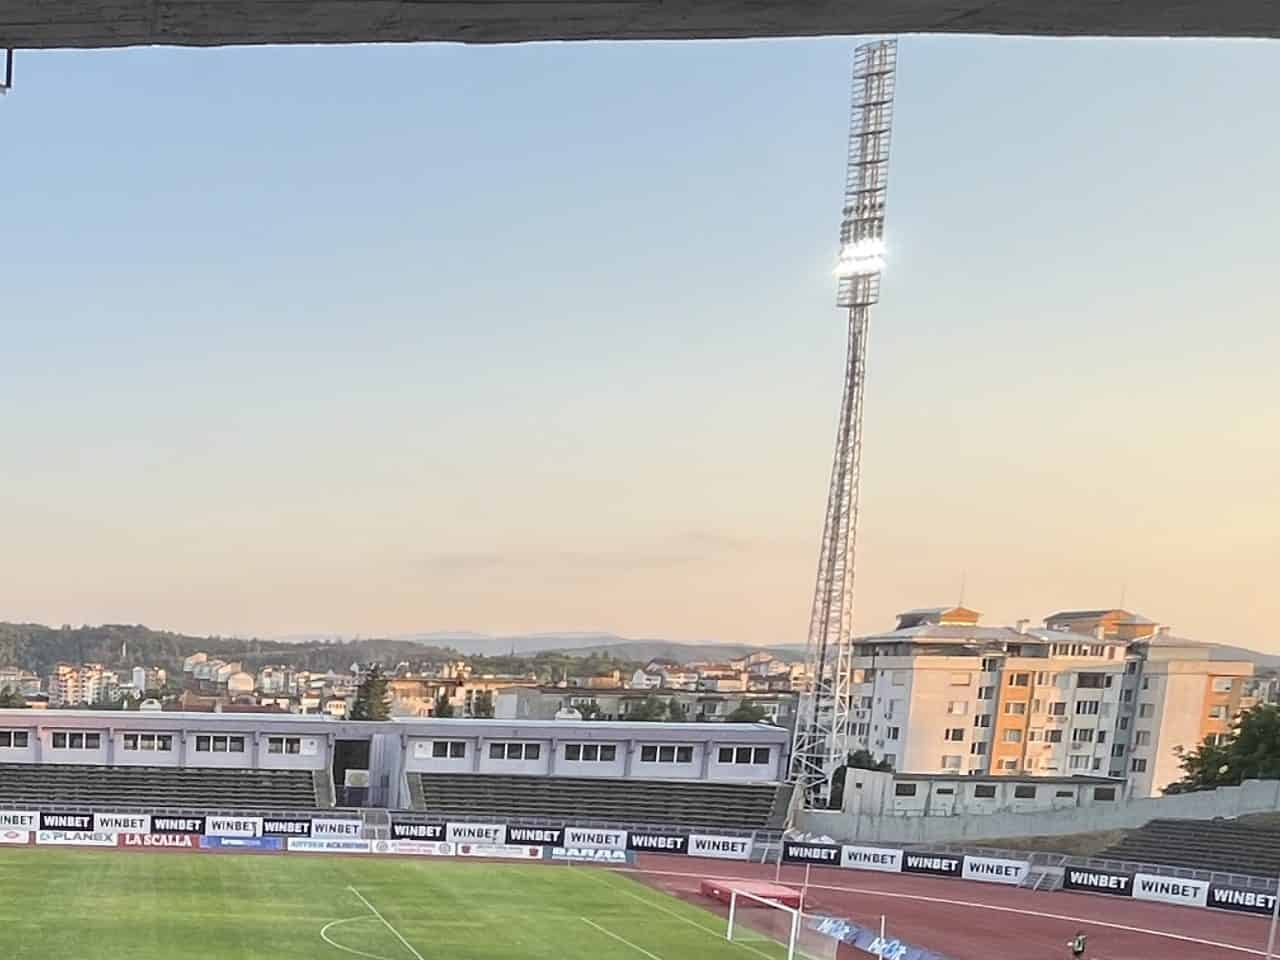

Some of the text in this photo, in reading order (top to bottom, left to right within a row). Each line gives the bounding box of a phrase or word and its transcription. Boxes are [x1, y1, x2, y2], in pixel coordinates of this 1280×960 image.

[42, 815, 91, 828] WINBET
[100, 817, 145, 829] WINBET
[154, 818, 202, 831] WINBET
[211, 820, 257, 832] WINBET
[264, 821, 310, 833] WINBET
[314, 822, 360, 835] WINBET
[394, 824, 442, 837] WINBET
[452, 828, 499, 840] WINBET
[510, 828, 561, 842] WINBET
[126, 834, 193, 847] LA SCALLA
[571, 832, 620, 844] WINBET
[632, 835, 684, 849] WINBET
[695, 839, 747, 853] WINBET
[788, 846, 838, 860] WINBET
[848, 851, 896, 865] WINBET
[906, 856, 959, 872] WINBET
[970, 862, 1021, 878] WINBET
[1070, 871, 1129, 889] WINBET
[1141, 880, 1201, 898] WINBET
[1214, 889, 1277, 909] WINBET
